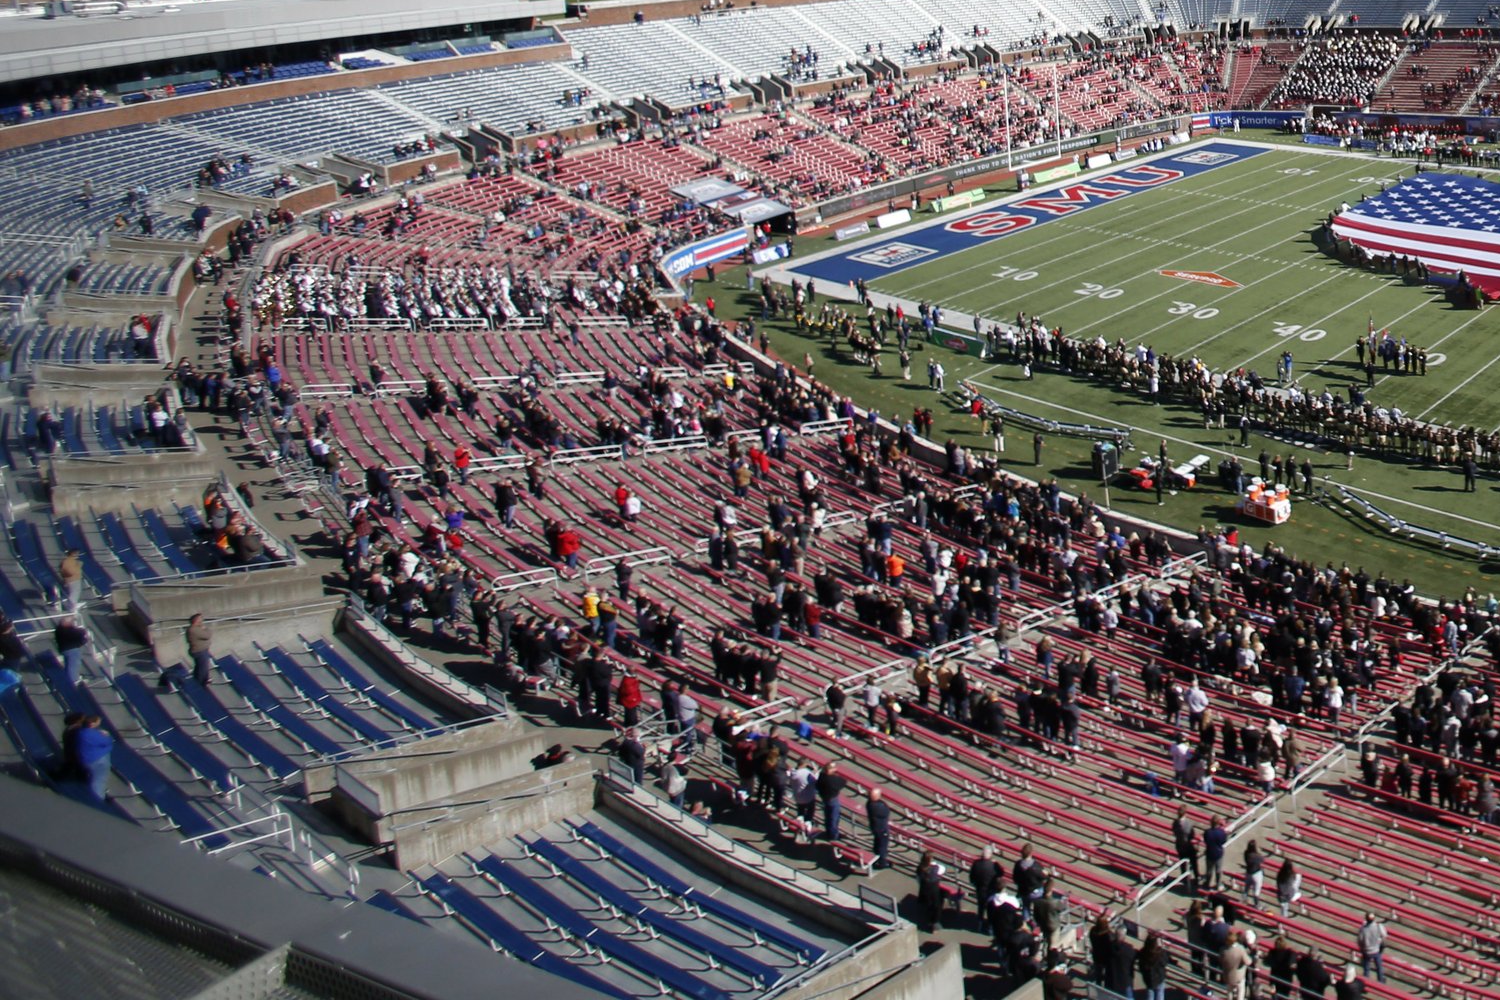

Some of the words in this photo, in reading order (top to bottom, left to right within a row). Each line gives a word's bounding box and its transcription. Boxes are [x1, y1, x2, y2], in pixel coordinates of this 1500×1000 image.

[955, 166, 976, 176] THANK
[1043, 146, 1059, 155] FIRST
[1060, 137, 1098, 150] RESPONDERS
[944, 164, 1184, 238] SMU
